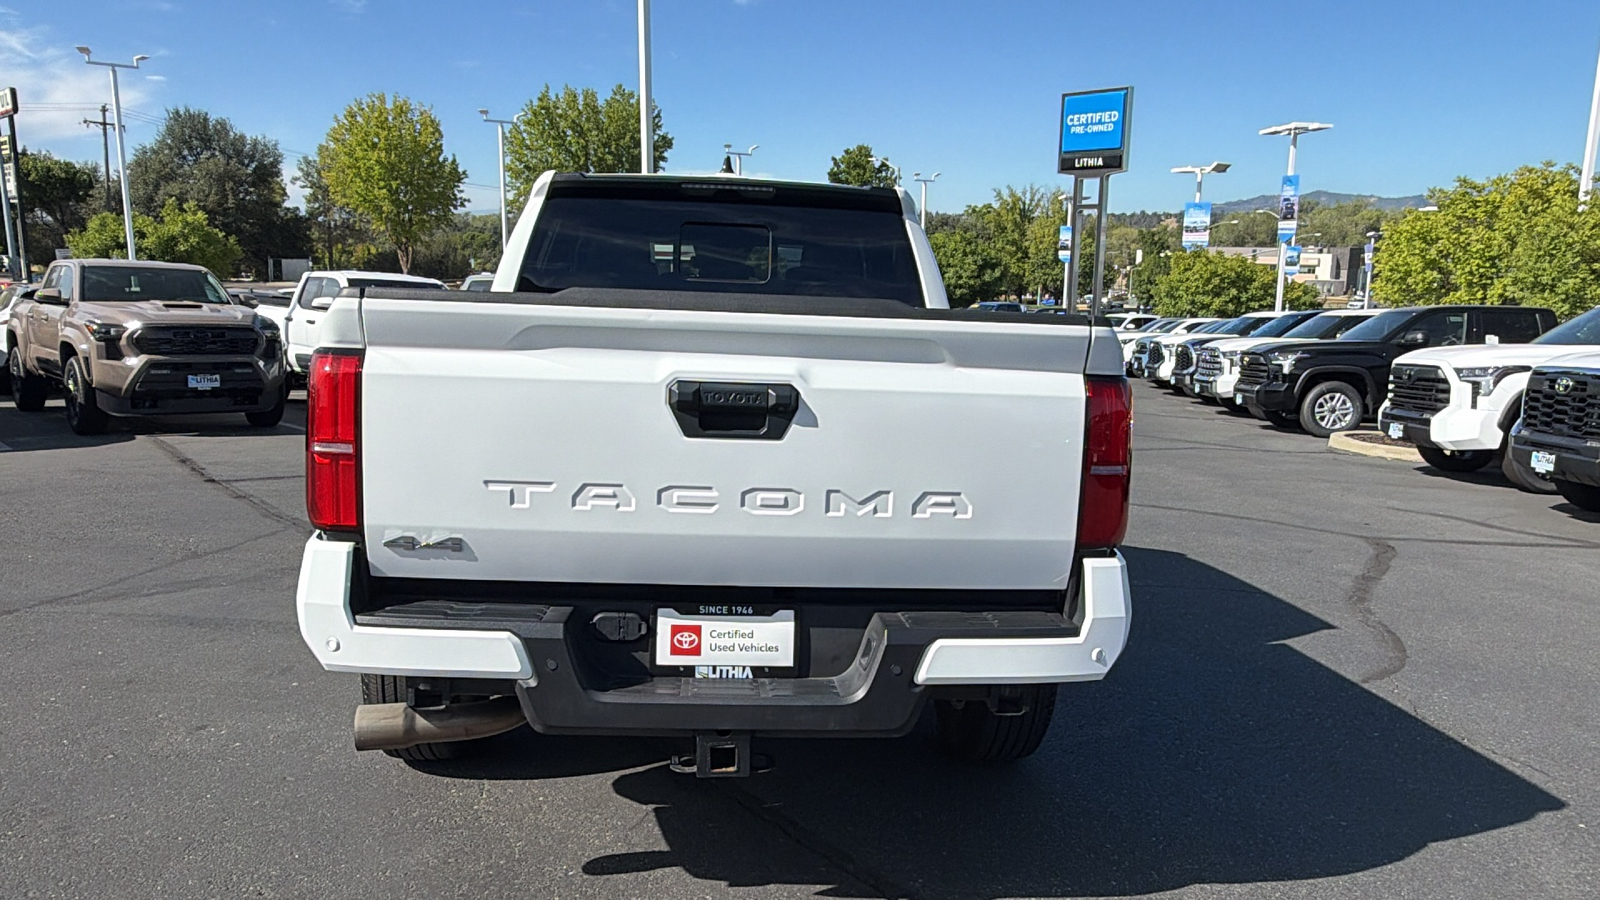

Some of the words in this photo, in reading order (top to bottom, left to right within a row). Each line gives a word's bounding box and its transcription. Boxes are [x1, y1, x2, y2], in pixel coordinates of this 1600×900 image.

[1066, 111, 1119, 126] CERTIFIED
[1070, 123, 1114, 134] PRE-OWNED
[1074, 157, 1104, 168] LITHIA
[703, 390, 766, 405] TOYOTA
[483, 479, 975, 520] TACOMA
[699, 605, 728, 614] SINCE
[731, 606, 753, 614] 1946
[709, 629, 754, 639] Certified
[709, 643, 735, 652] Used
[738, 643, 779, 652] Vehicles
[707, 666, 753, 679] LITHIA
